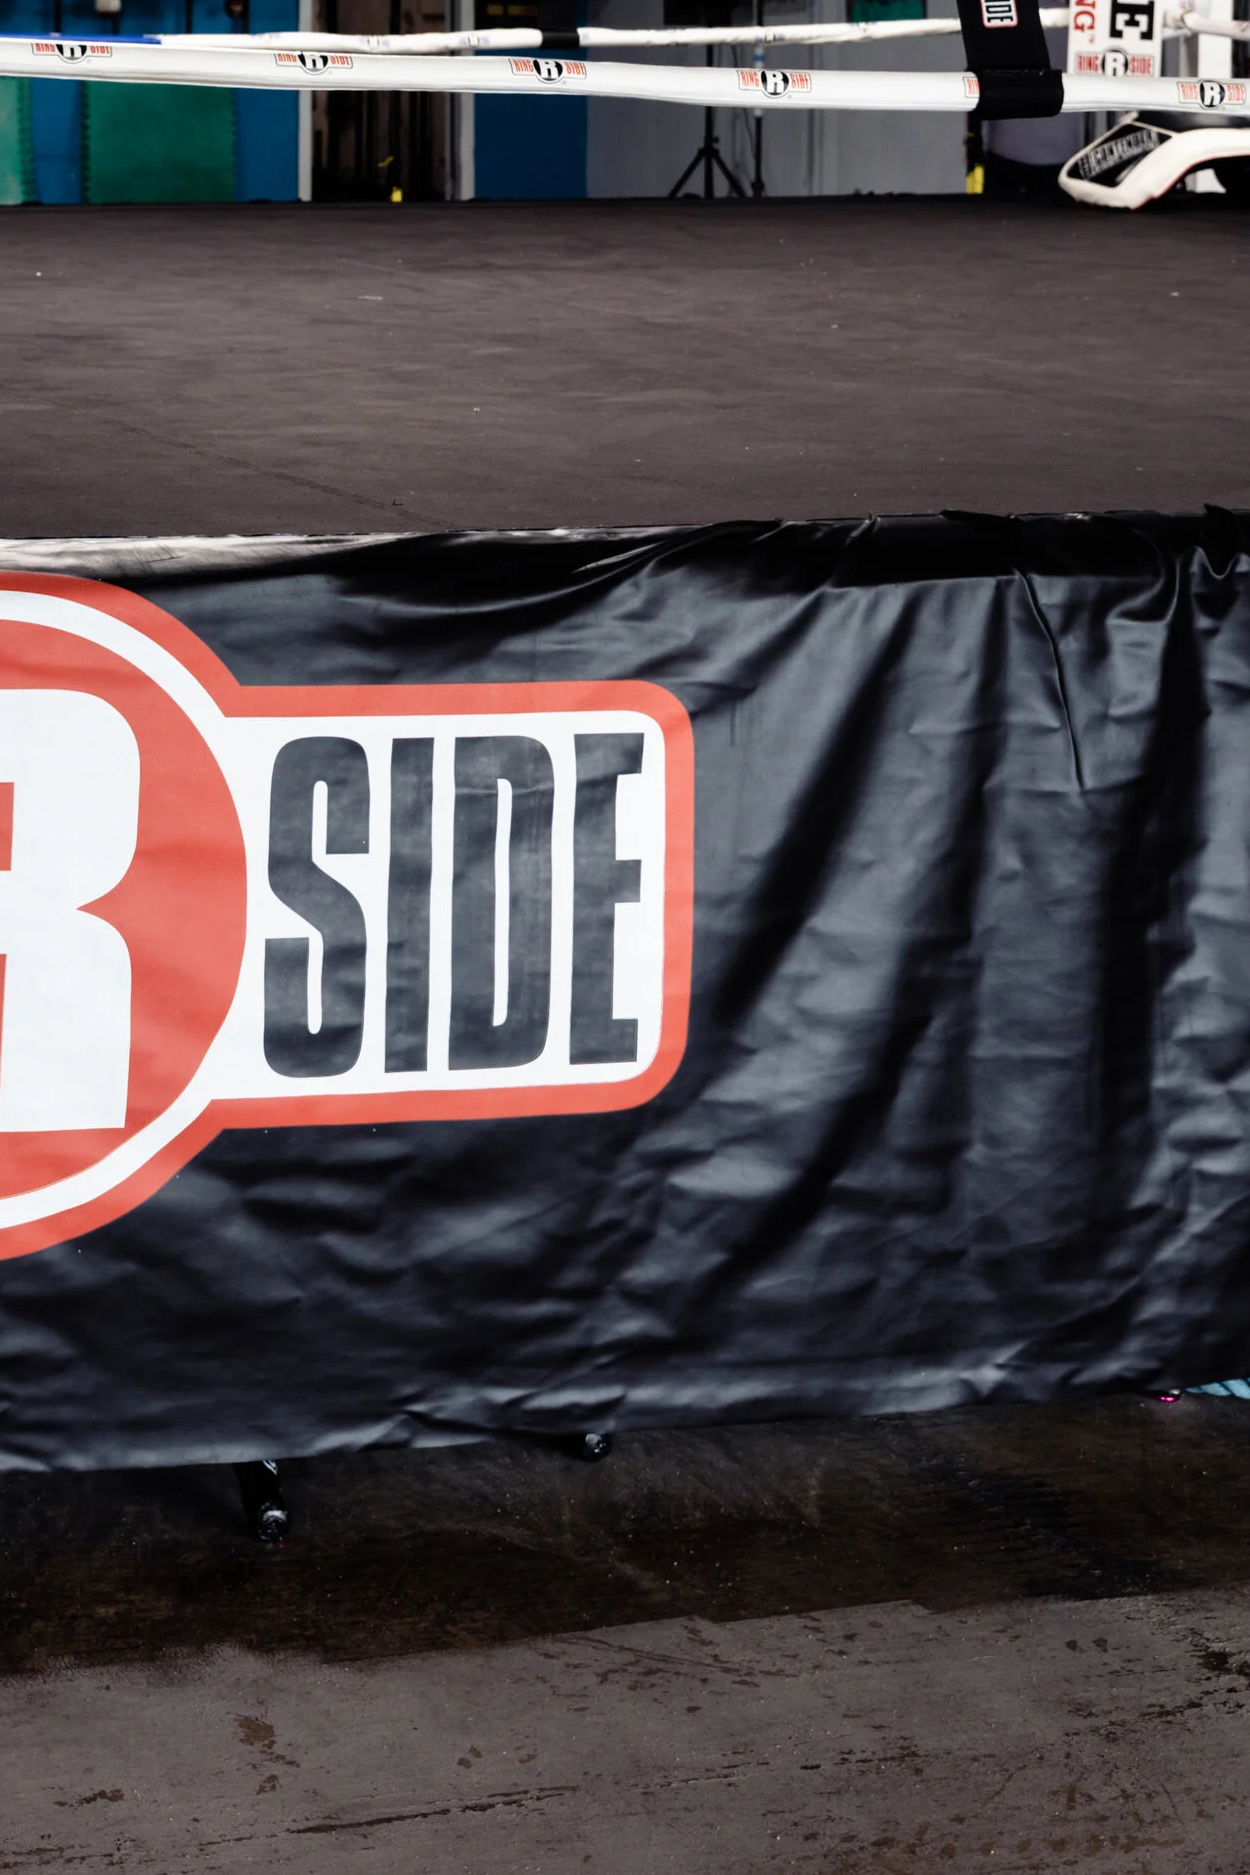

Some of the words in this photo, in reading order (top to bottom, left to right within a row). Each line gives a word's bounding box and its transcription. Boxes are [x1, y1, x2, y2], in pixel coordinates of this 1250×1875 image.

[765, 70, 784, 95] R
[1204, 80, 1222, 106] R
[262, 732, 645, 1078] SIDE
